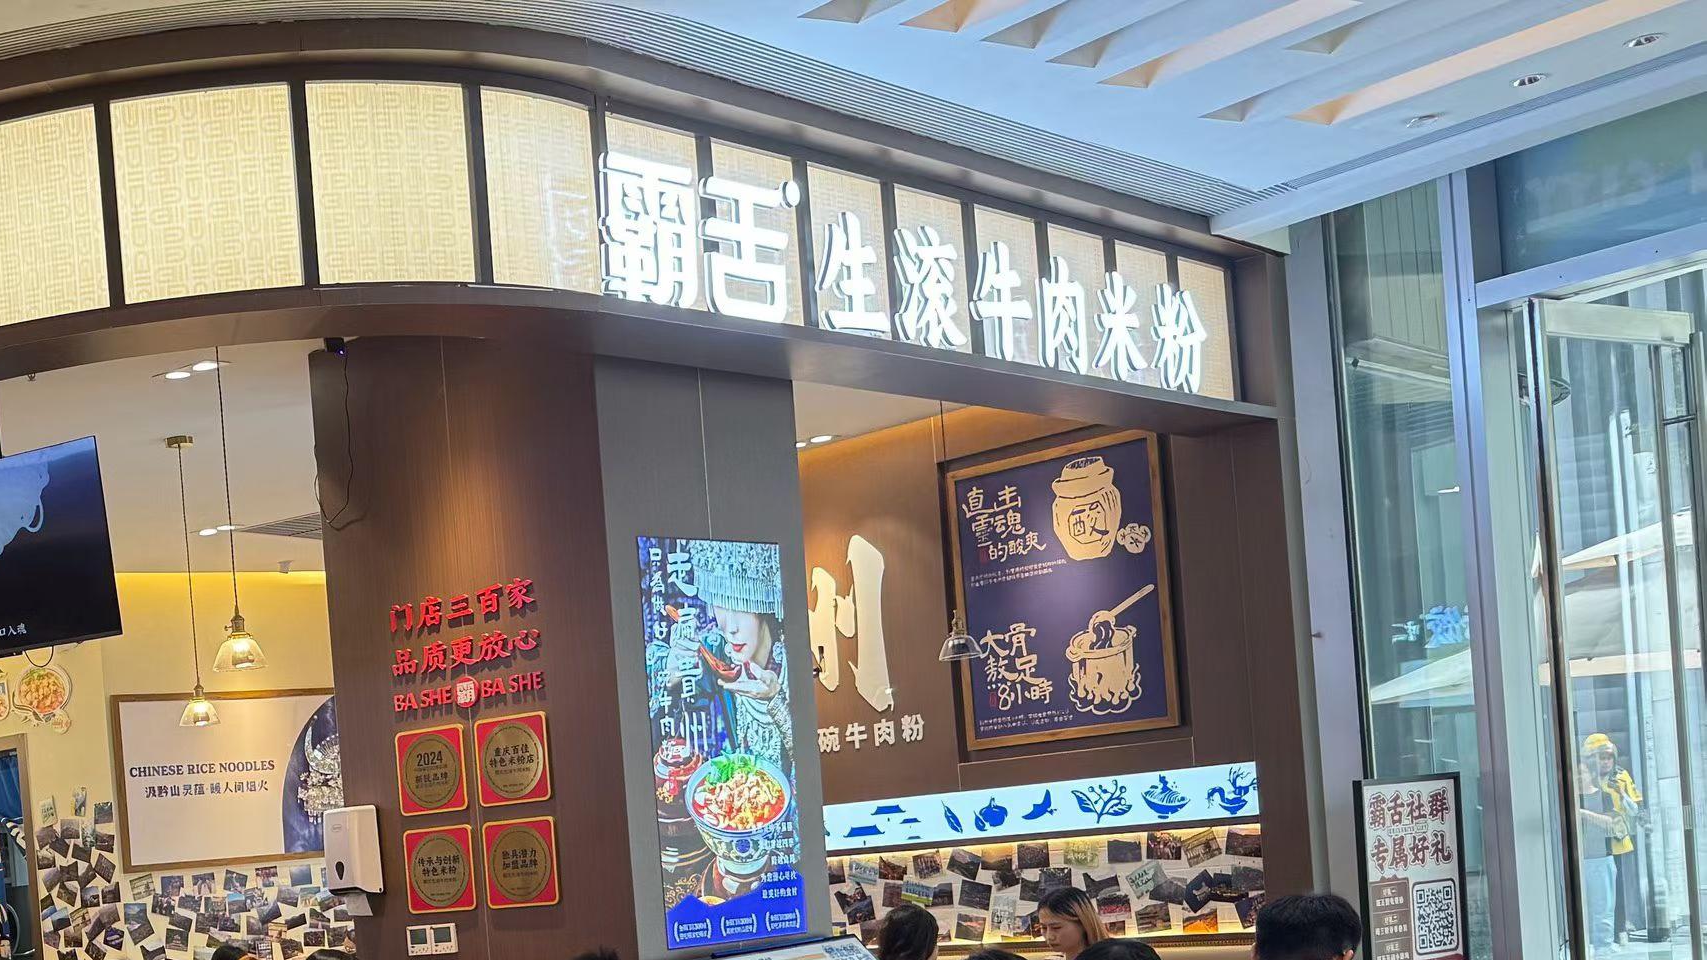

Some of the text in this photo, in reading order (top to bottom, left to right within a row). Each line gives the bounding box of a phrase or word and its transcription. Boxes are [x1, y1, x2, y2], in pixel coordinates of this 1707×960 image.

[599, 152, 1206, 393] 霸舌 生滚牛肉米粉
[390, 577, 534, 632] 门店三百家
[392, 628, 541, 676] 品质更放心
[980, 622, 1036, 658] 大骨
[394, 693, 418, 712] BA
[420, 685, 452, 707] SHE
[481, 678, 506, 698] BA
[509, 671, 543, 692] SHE
[416, 751, 443, 767] 2024
[489, 754, 535, 768] 特色米粉店
[494, 744, 530, 757] 重庆百佳
[129, 760, 275, 778] CHINESE RICE NOODLES
[1369, 788, 1450, 828] 霸舌社群
[417, 854, 460, 867] 传承与创新
[502, 858, 538, 870] 加盟品牌
[1371, 831, 1453, 872] 专属好礼
[421, 866, 457, 878] 特色米粉
